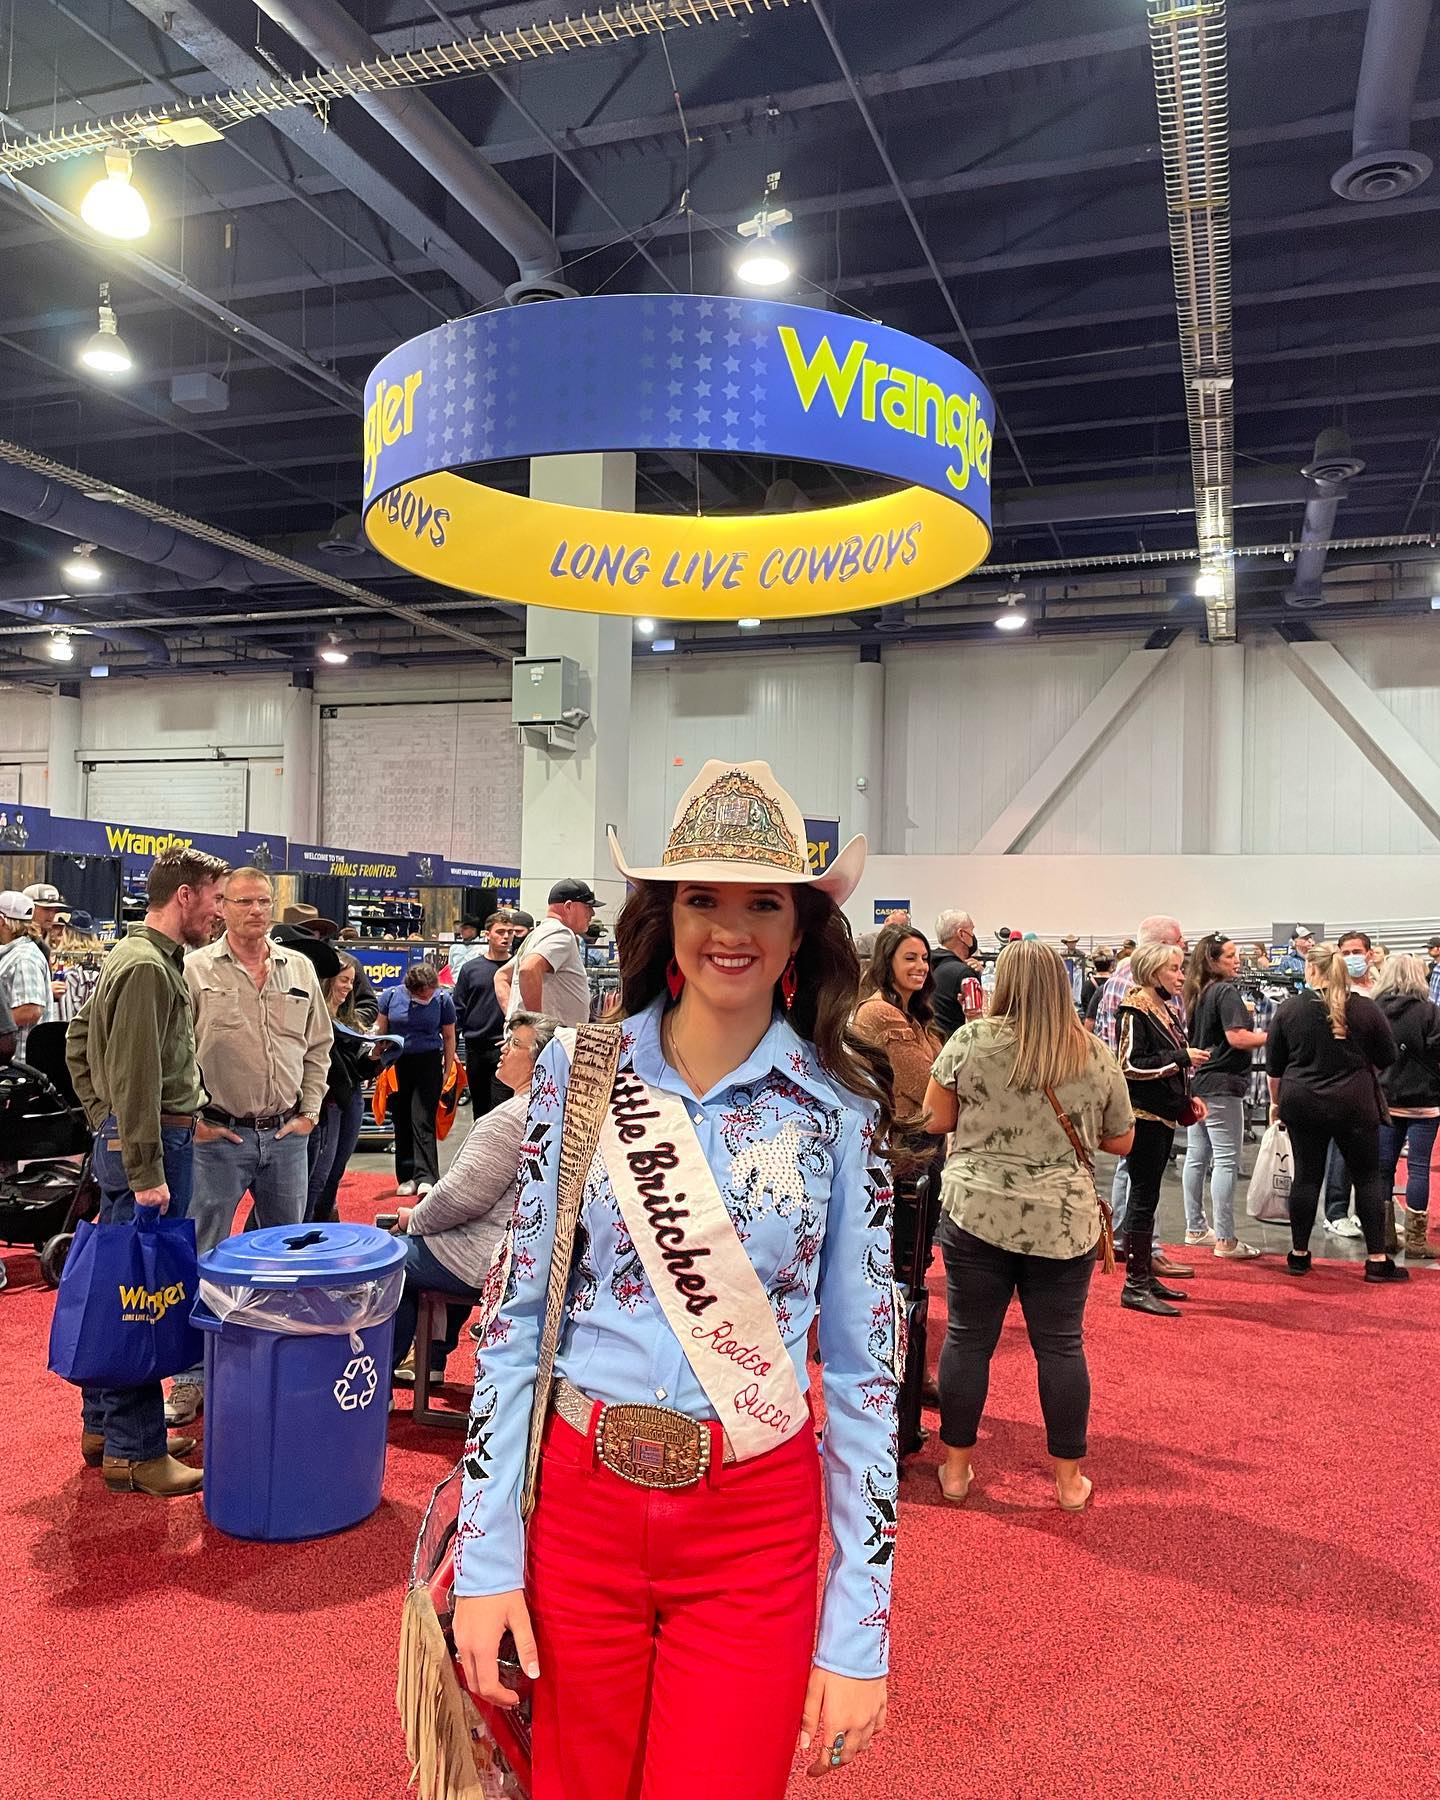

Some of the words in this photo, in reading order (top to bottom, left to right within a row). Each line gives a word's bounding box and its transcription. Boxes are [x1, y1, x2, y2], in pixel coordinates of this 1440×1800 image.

[550, 541, 651, 586] LONG
[662, 550, 749, 592] LIVE
[759, 521, 922, 589] COWBOYS
[304, 852, 328, 862] WELCOME
[328, 854, 336, 862] TO
[329, 861, 359, 877] FINALS
[358, 863, 398, 878] FRONTIER.
[626, 1141, 719, 1317] Britches
[691, 1321, 771, 1377] Rodeo
[734, 1383, 791, 1434] Queen
[622, 1461, 672, 1481] Queen
